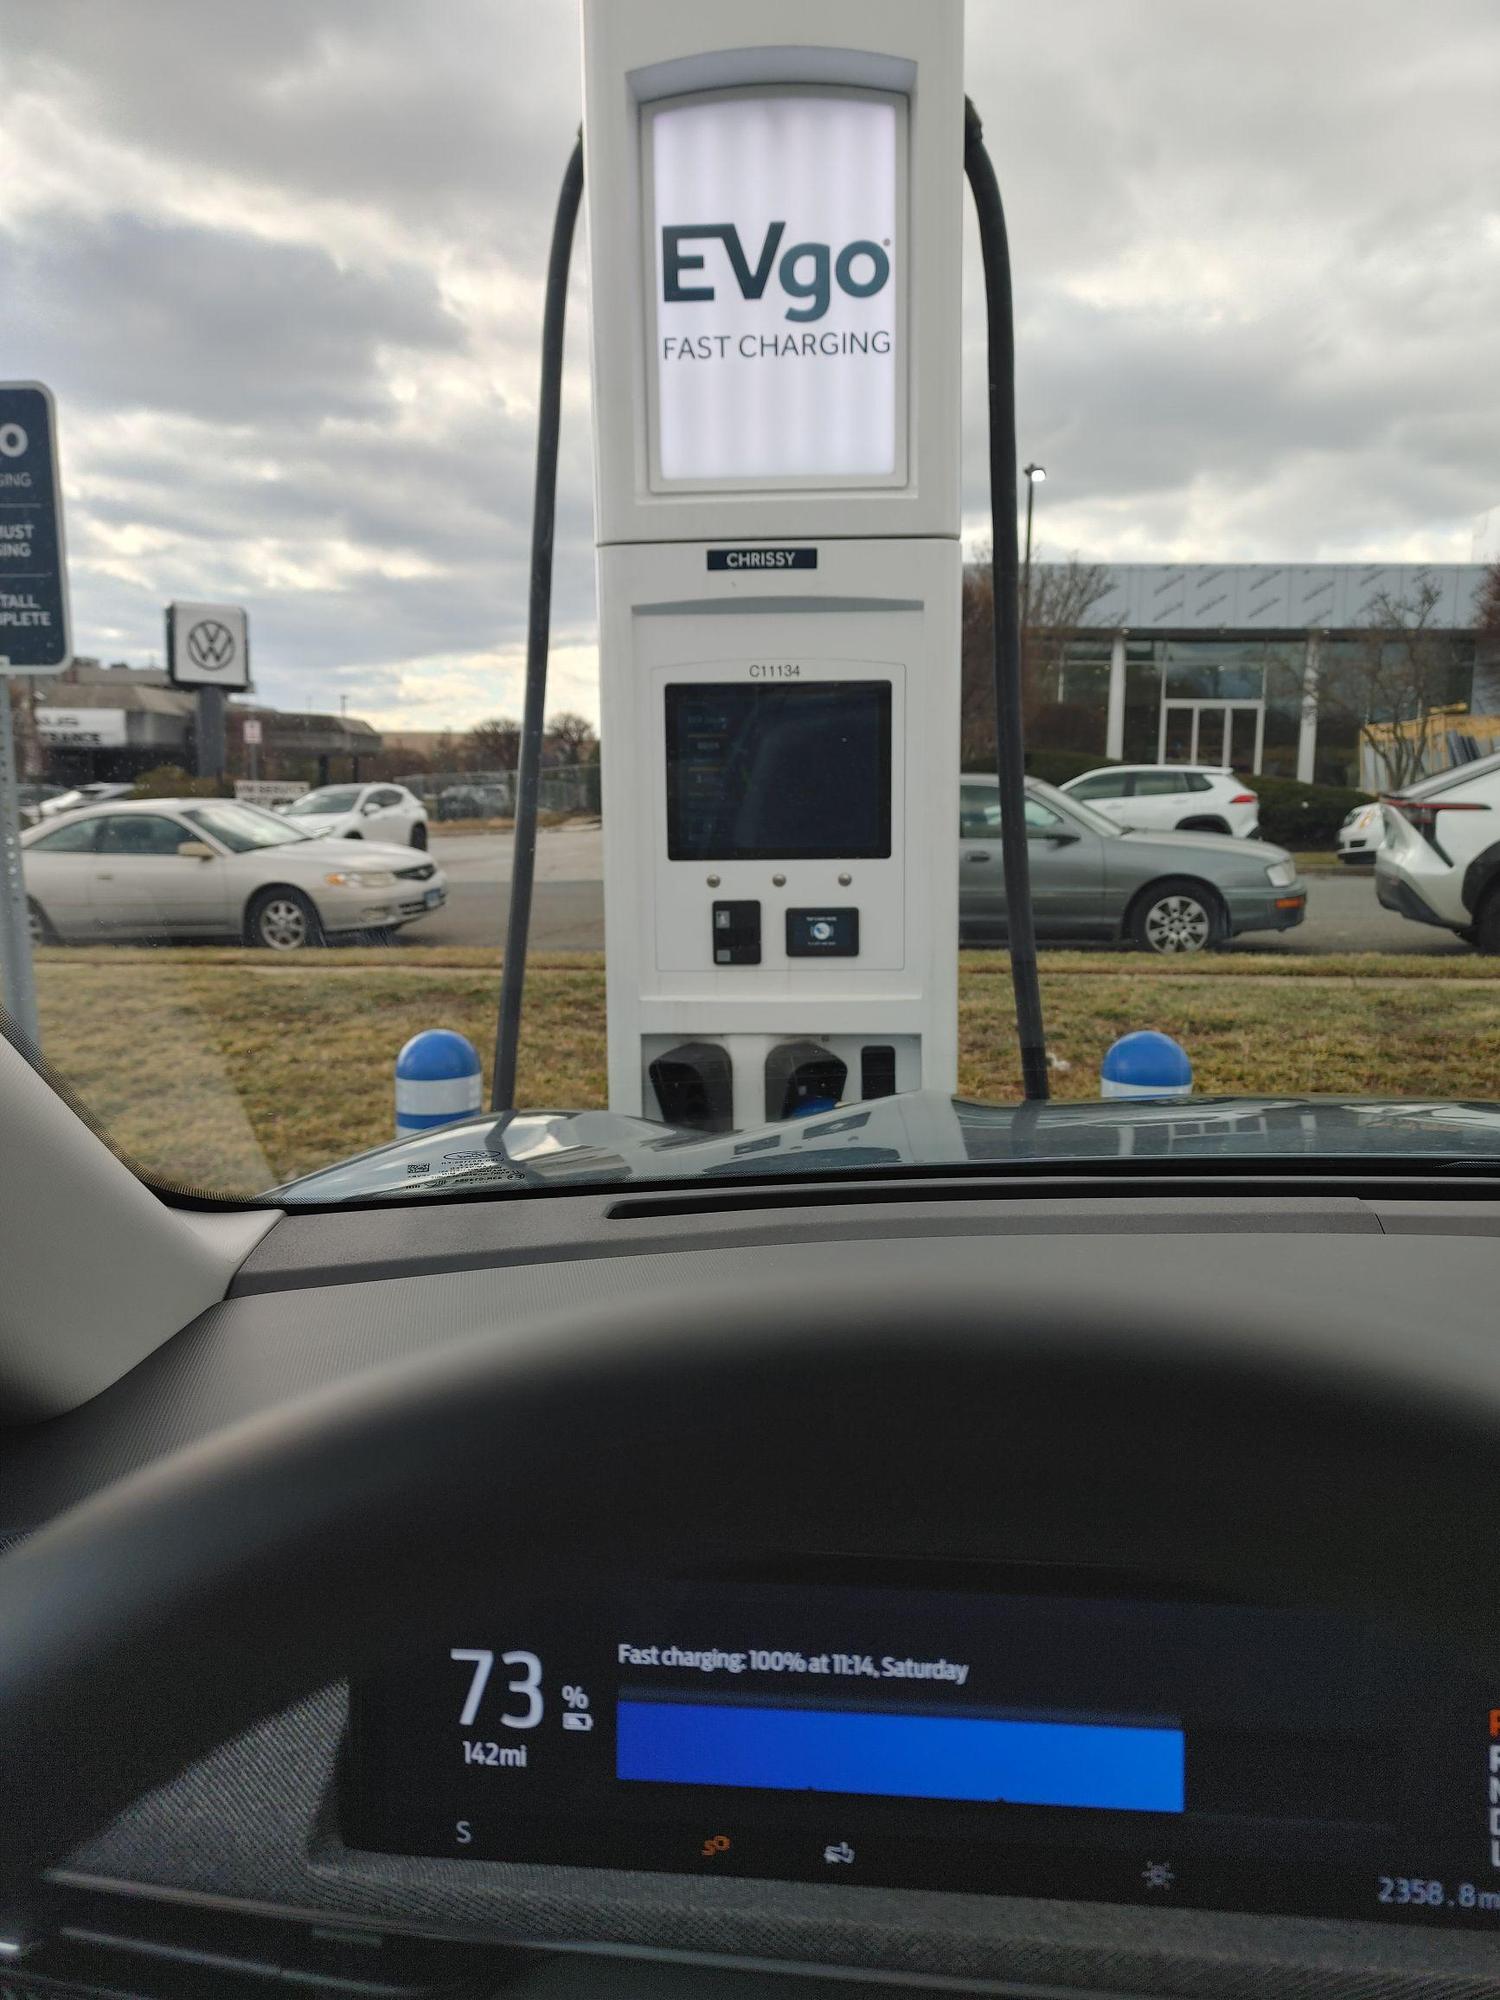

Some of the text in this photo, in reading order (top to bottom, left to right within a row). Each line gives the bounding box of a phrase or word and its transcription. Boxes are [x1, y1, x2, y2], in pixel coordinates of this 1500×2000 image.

[662, 221, 890, 323] EVgo
[663, 331, 891, 360] FAST CHARGING
[0, 542, 32, 557] ING
[726, 551, 796, 567] CHRISSY
[749, 664, 800, 678] C11134
[618, 1643, 660, 1665] Fast
[749, 1649, 807, 1673] 100%
[808, 1653, 831, 1674] at
[880, 1656, 970, 1685] Saturday
[450, 1648, 544, 1729] 73
[462, 1740, 528, 1768] 142mi
[456, 1820, 472, 1844] S
